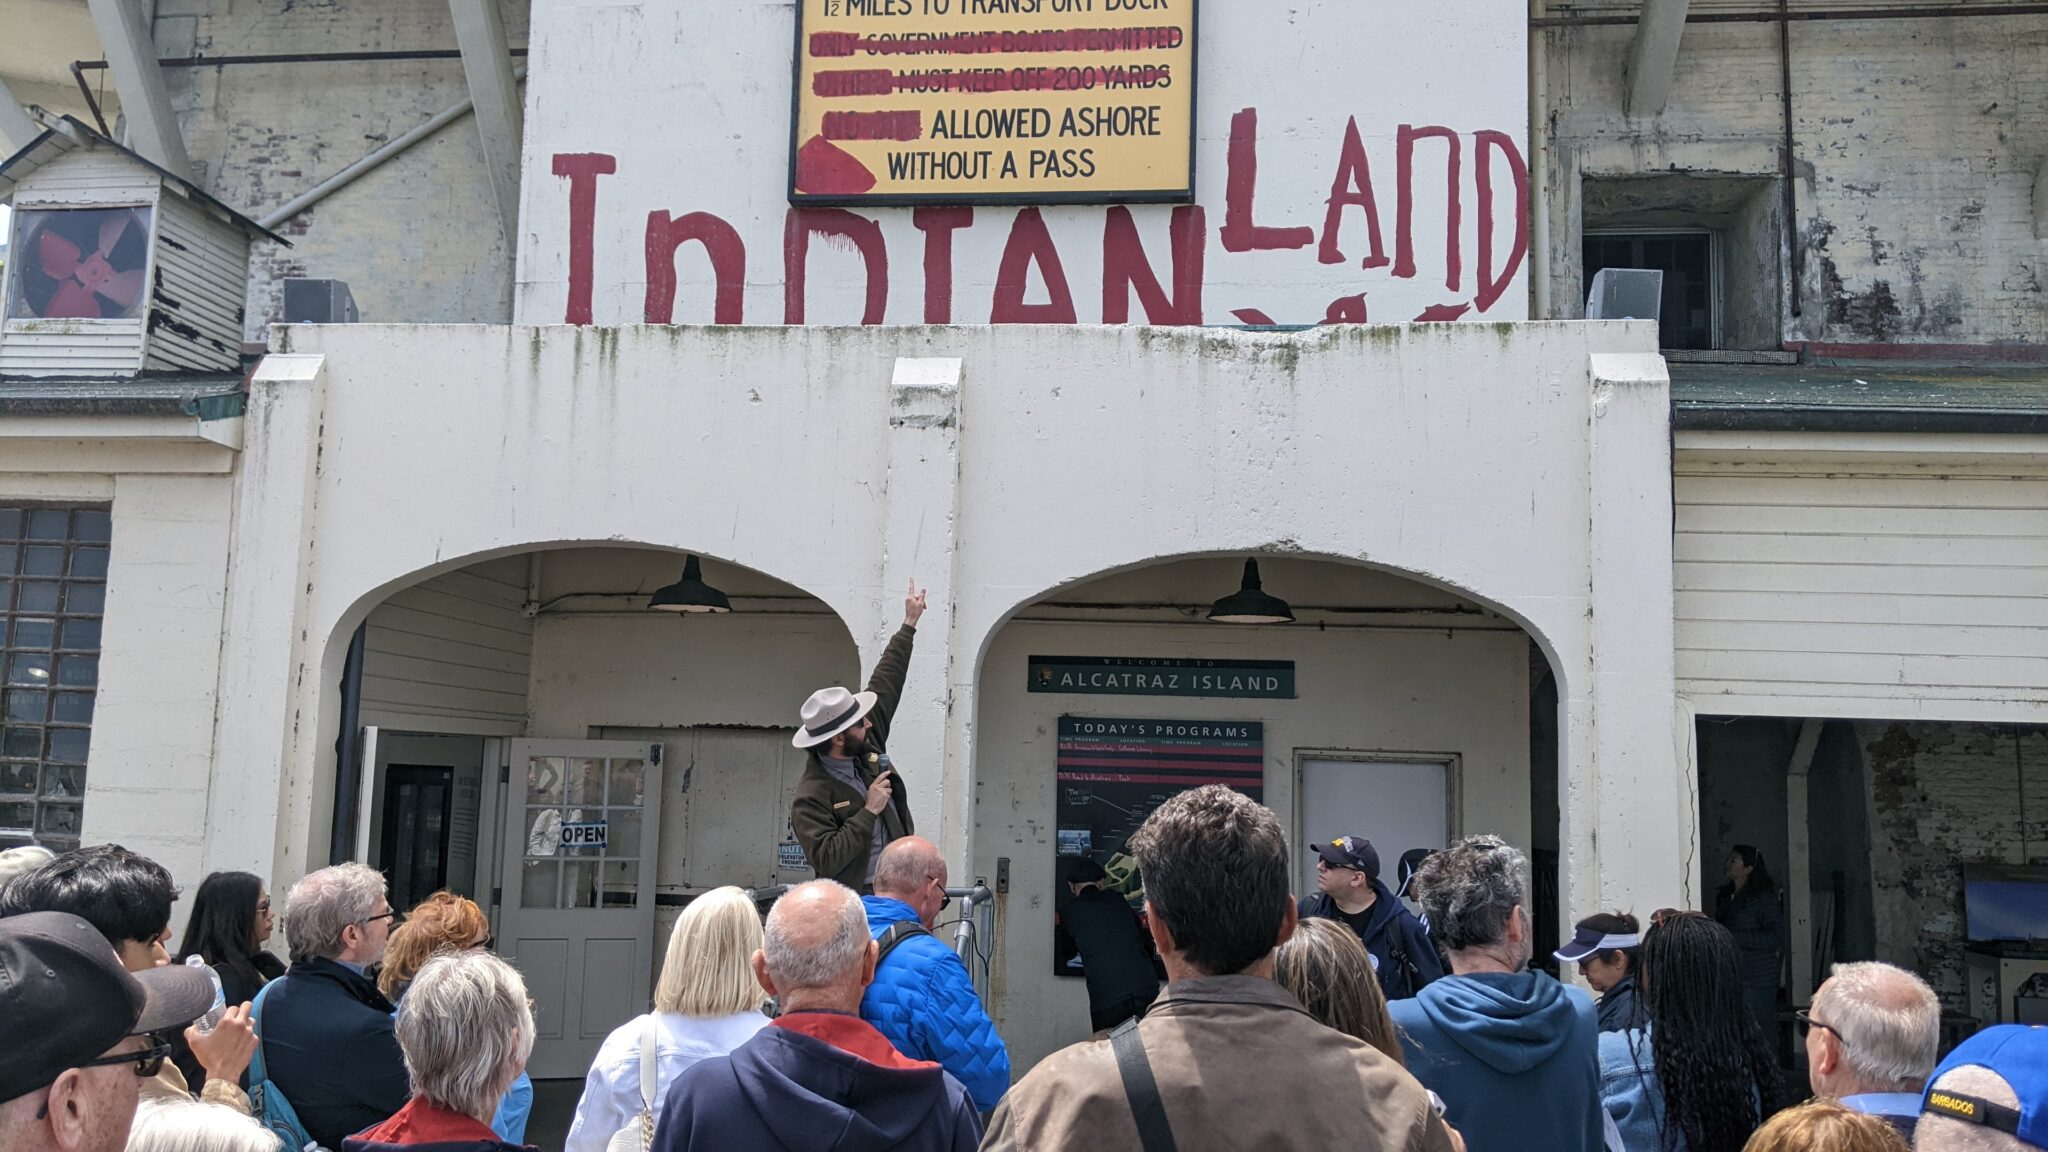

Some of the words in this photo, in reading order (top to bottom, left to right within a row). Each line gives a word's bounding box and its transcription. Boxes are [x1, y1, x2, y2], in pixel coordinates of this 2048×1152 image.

[846, 0, 913, 16] MILES
[899, 68, 953, 93] MUST
[959, 67, 1006, 93] KEEP
[1011, 66, 1047, 91] OFF
[1053, 65, 1096, 91] 200
[1101, 64, 1172, 90] YARDS
[930, 108, 1051, 139] ALLOWED
[1059, 106, 1161, 138] ASHORE
[887, 151, 993, 181] WITHOUT
[1000, 151, 1018, 179] A
[1029, 148, 1096, 179] PASS
[1103, 658, 1181, 667] WELCOME
[1061, 672, 1179, 689] ALCATRAZ
[1192, 675, 1279, 691] ISLAND
[1074, 723, 1145, 735] TODAY'S
[1156, 725, 1248, 738] PROGRAMS
[561, 826, 606, 843] OPEN
[1930, 1093, 1974, 1115] BARBADOS
